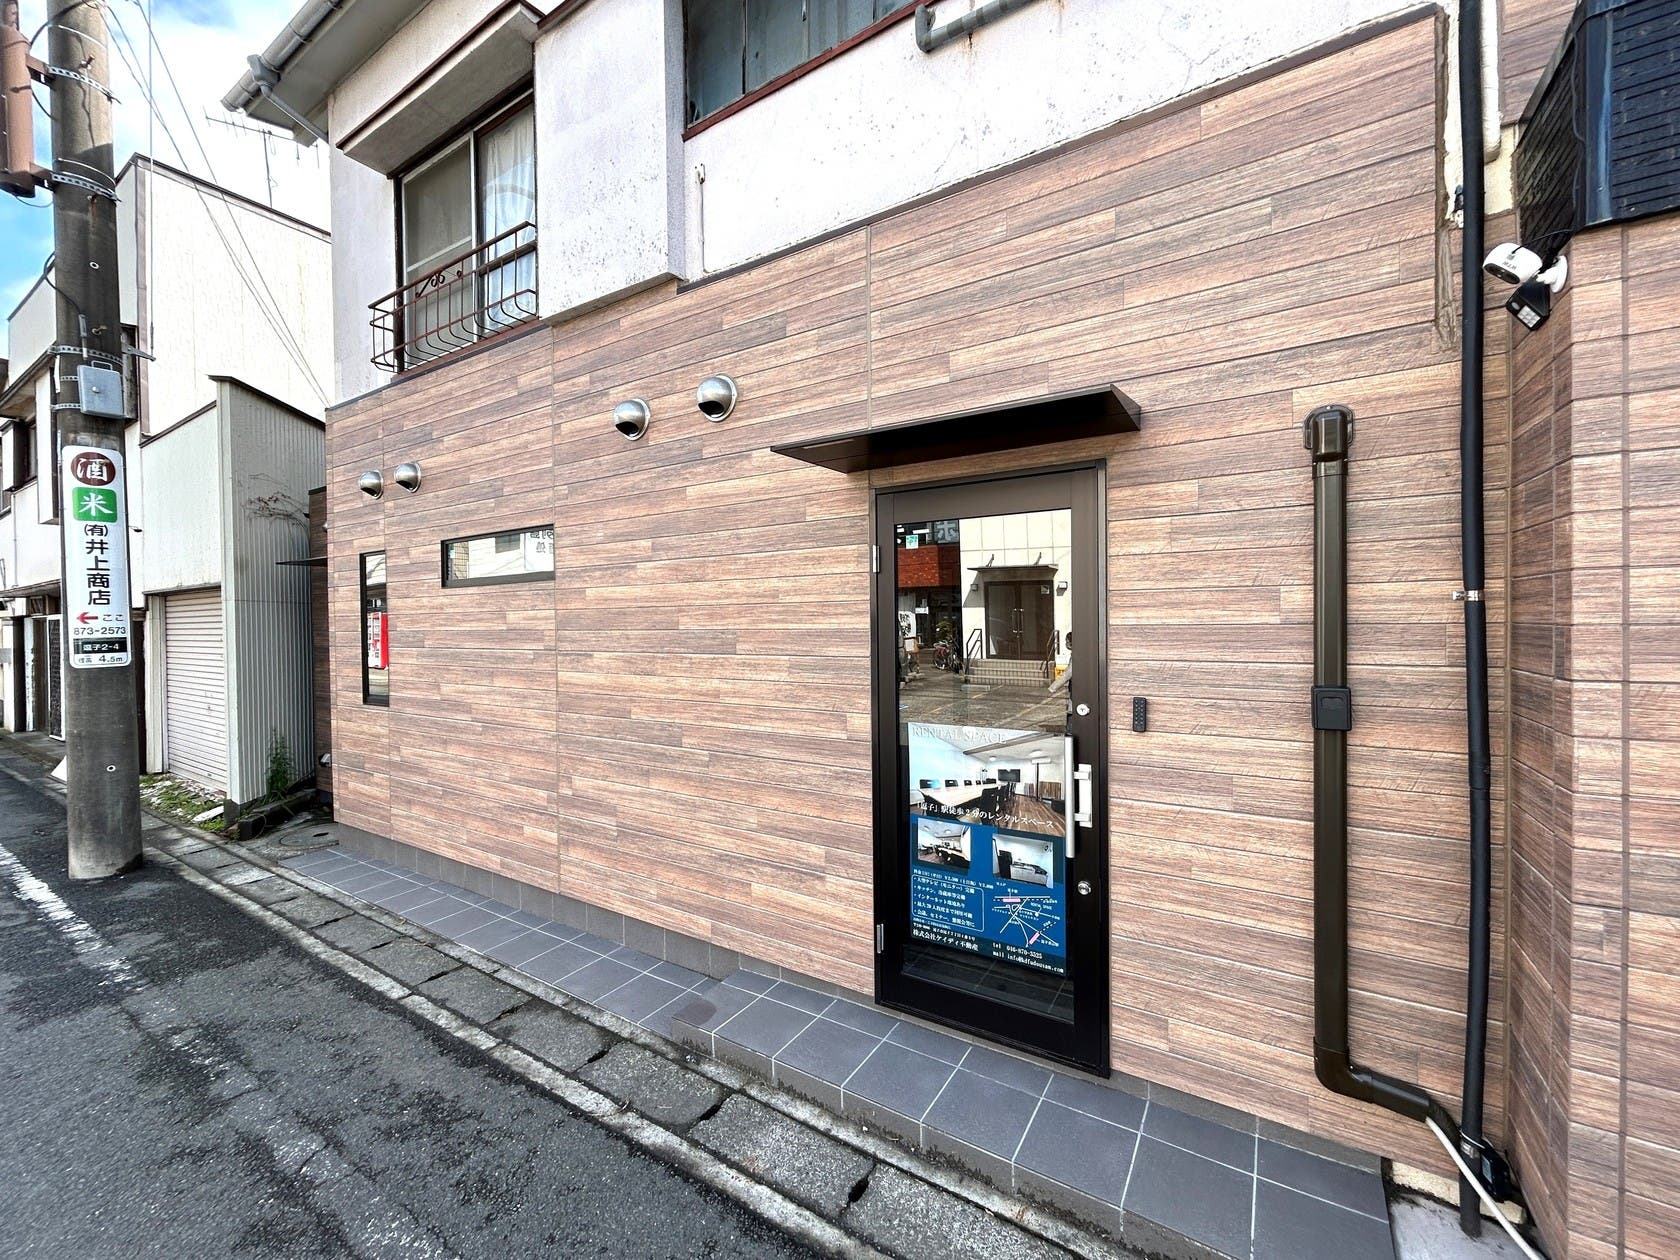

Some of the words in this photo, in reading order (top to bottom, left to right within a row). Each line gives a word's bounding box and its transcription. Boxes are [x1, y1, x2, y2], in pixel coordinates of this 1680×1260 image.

[77, 458, 110, 482] 酒
[79, 492, 114, 517] 米
[84, 523, 111, 606] (有)井上商店
[103, 614, 124, 622] ここ
[73, 626, 126, 636] 873-2573
[99, 654, 123, 664] 4.5m
[913, 726, 960, 739] RENTAL
[964, 729, 1007, 744] SPACE
